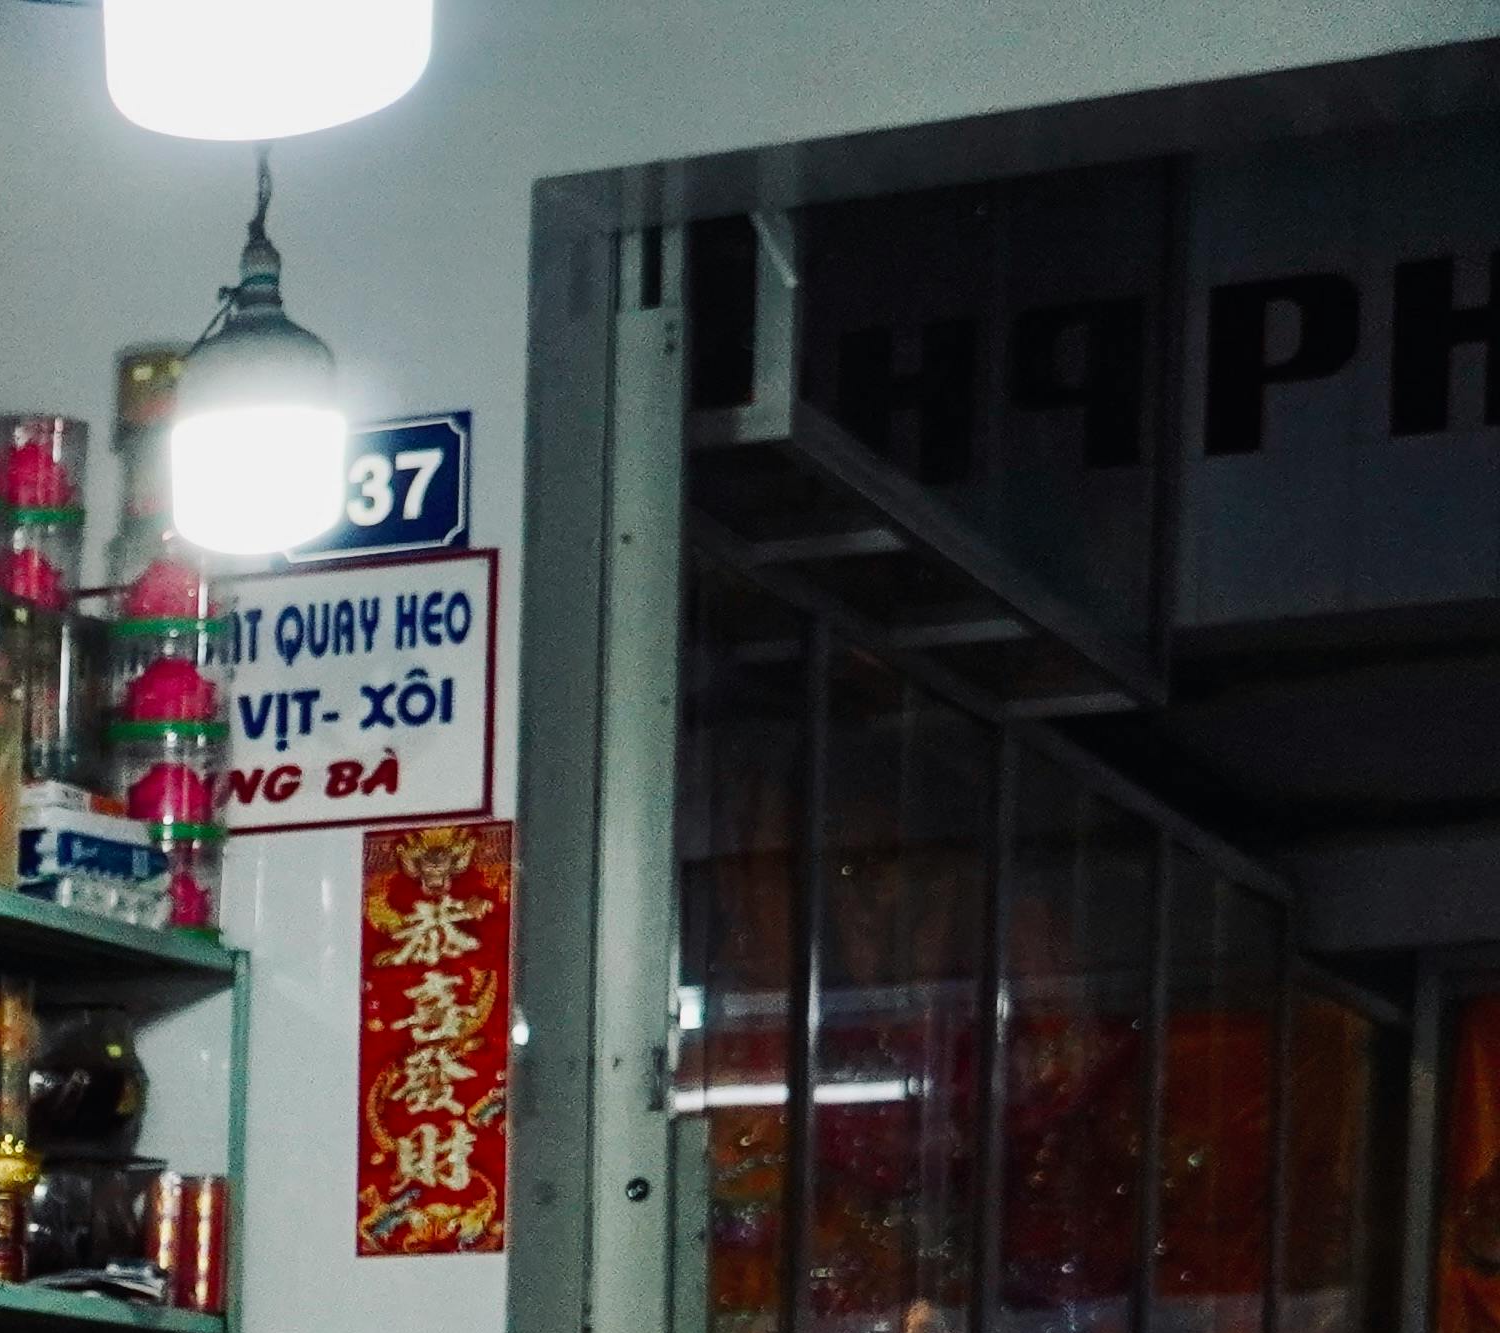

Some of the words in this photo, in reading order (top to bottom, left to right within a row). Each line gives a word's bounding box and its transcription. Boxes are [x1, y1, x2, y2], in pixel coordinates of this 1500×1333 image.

[275, 597, 380, 666] QUAY
[394, 590, 472, 650] HEO
[359, 668, 454, 729] XÔI
[324, 747, 399, 798] BÀ
